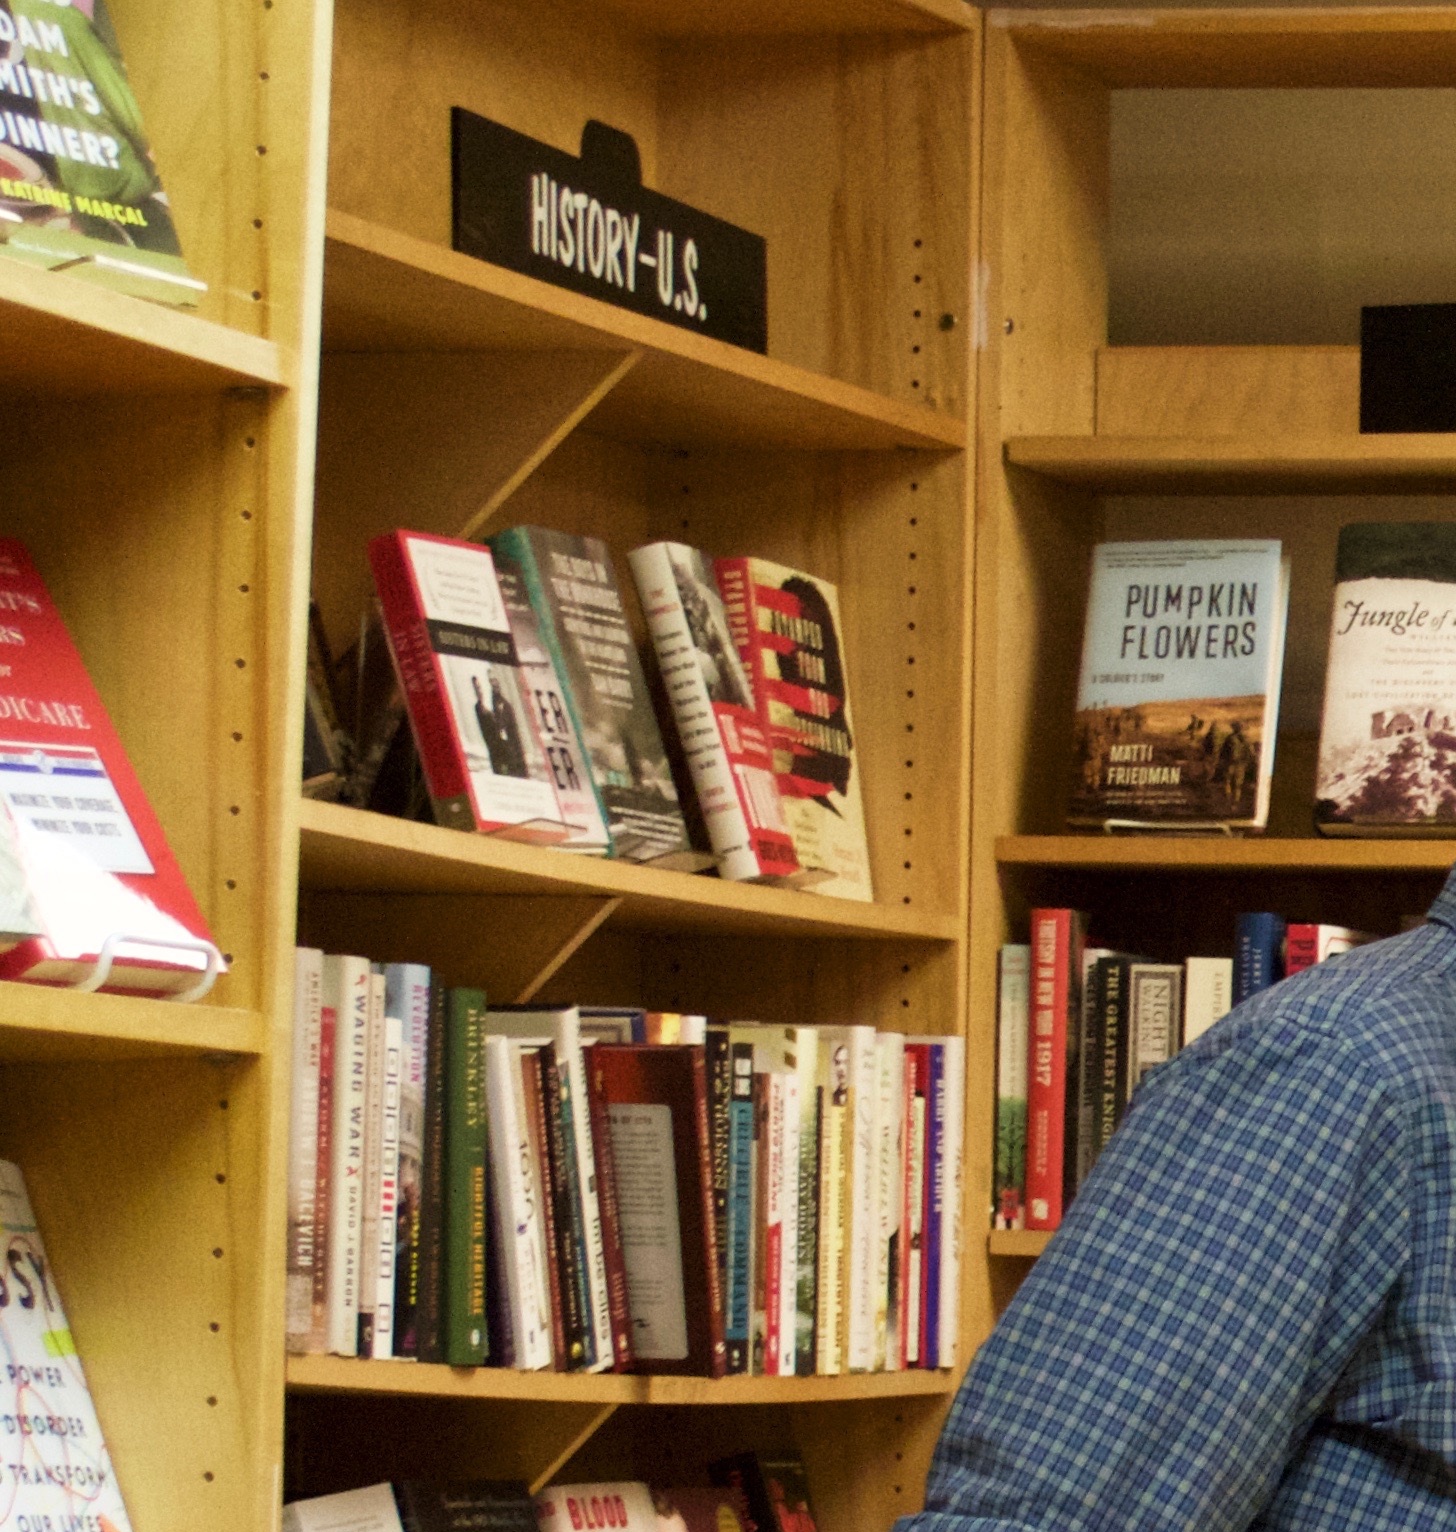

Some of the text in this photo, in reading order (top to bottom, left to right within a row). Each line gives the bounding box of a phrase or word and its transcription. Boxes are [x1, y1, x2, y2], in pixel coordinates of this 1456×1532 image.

[0, 9, 68, 58] DAM
[0, 61, 101, 116] MITH'S
[532, 172, 707, 321] HISTORY-U.S.
[1126, 581, 1258, 619] PUMPKIN
[1341, 600, 1427, 636] Jungle
[1431, 611, 1447, 631] of
[1120, 622, 1256, 660] FLOWERS
[1111, 743, 1153, 762] MATTI
[1107, 765, 1180, 786] FRIEDMAN
[352, 995, 366, 1092] WAGING
[8, 1364, 65, 1390] POWER
[5, 1414, 86, 1438] DISORDER
[9, 1464, 108, 1488] TRANSFORM
[568, 1495, 628, 1531] BLOOD
